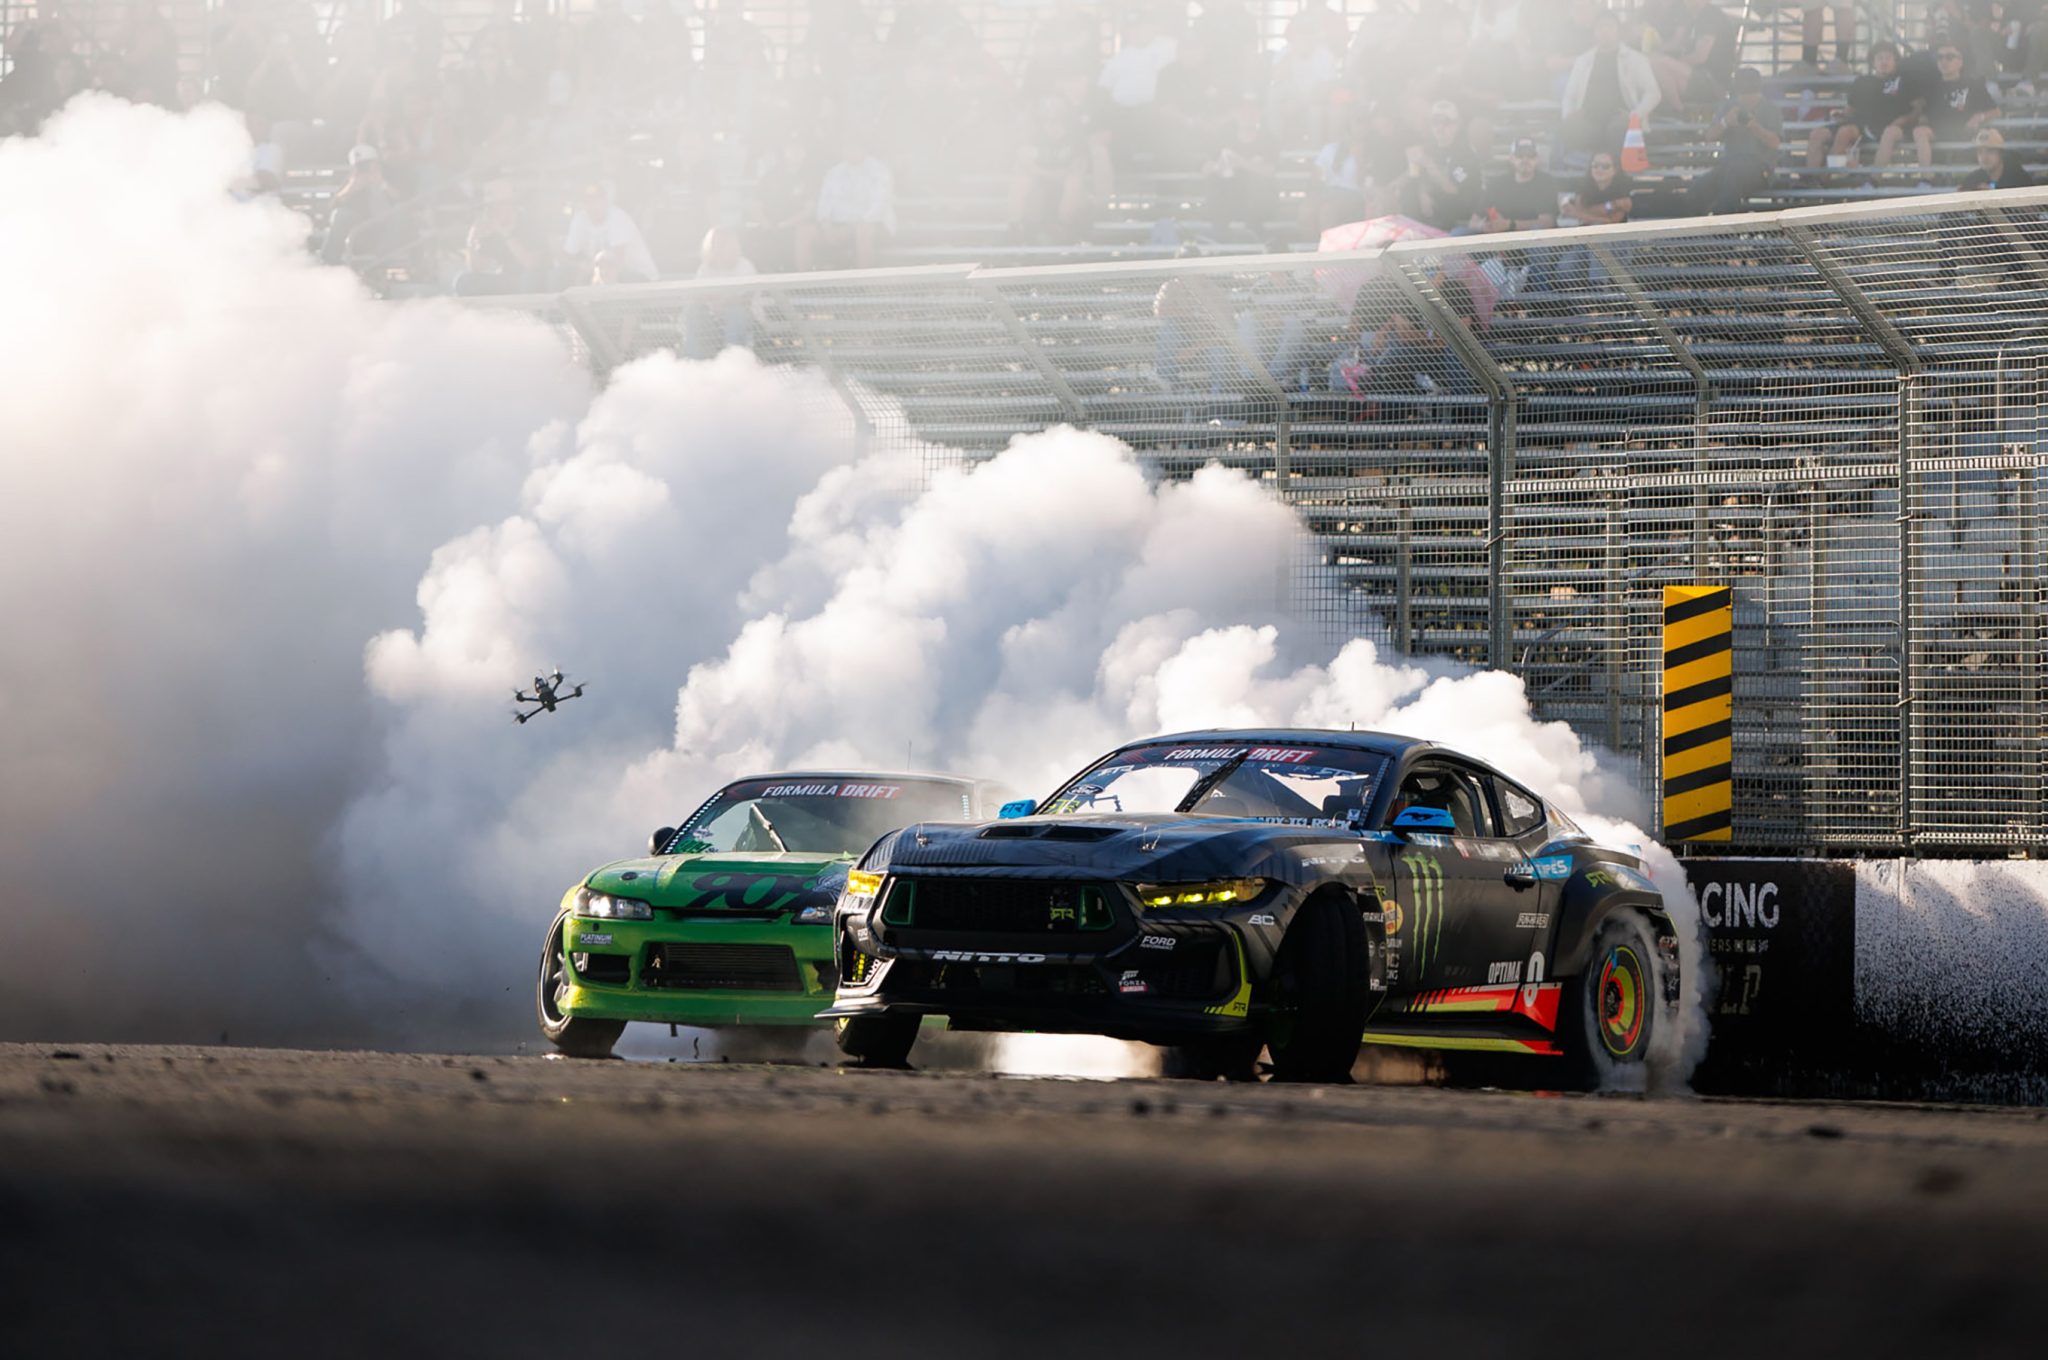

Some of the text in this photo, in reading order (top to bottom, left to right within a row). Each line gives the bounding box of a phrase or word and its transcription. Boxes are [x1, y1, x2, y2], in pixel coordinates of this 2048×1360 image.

[1164, 748, 1313, 762] FORMULA DRIFT
[761, 784, 899, 798] FORMULA DRIFT
[1142, 936, 1176, 946] FORD
[933, 950, 1046, 962] NITTO
[1488, 961, 1521, 984] OPTIMA
